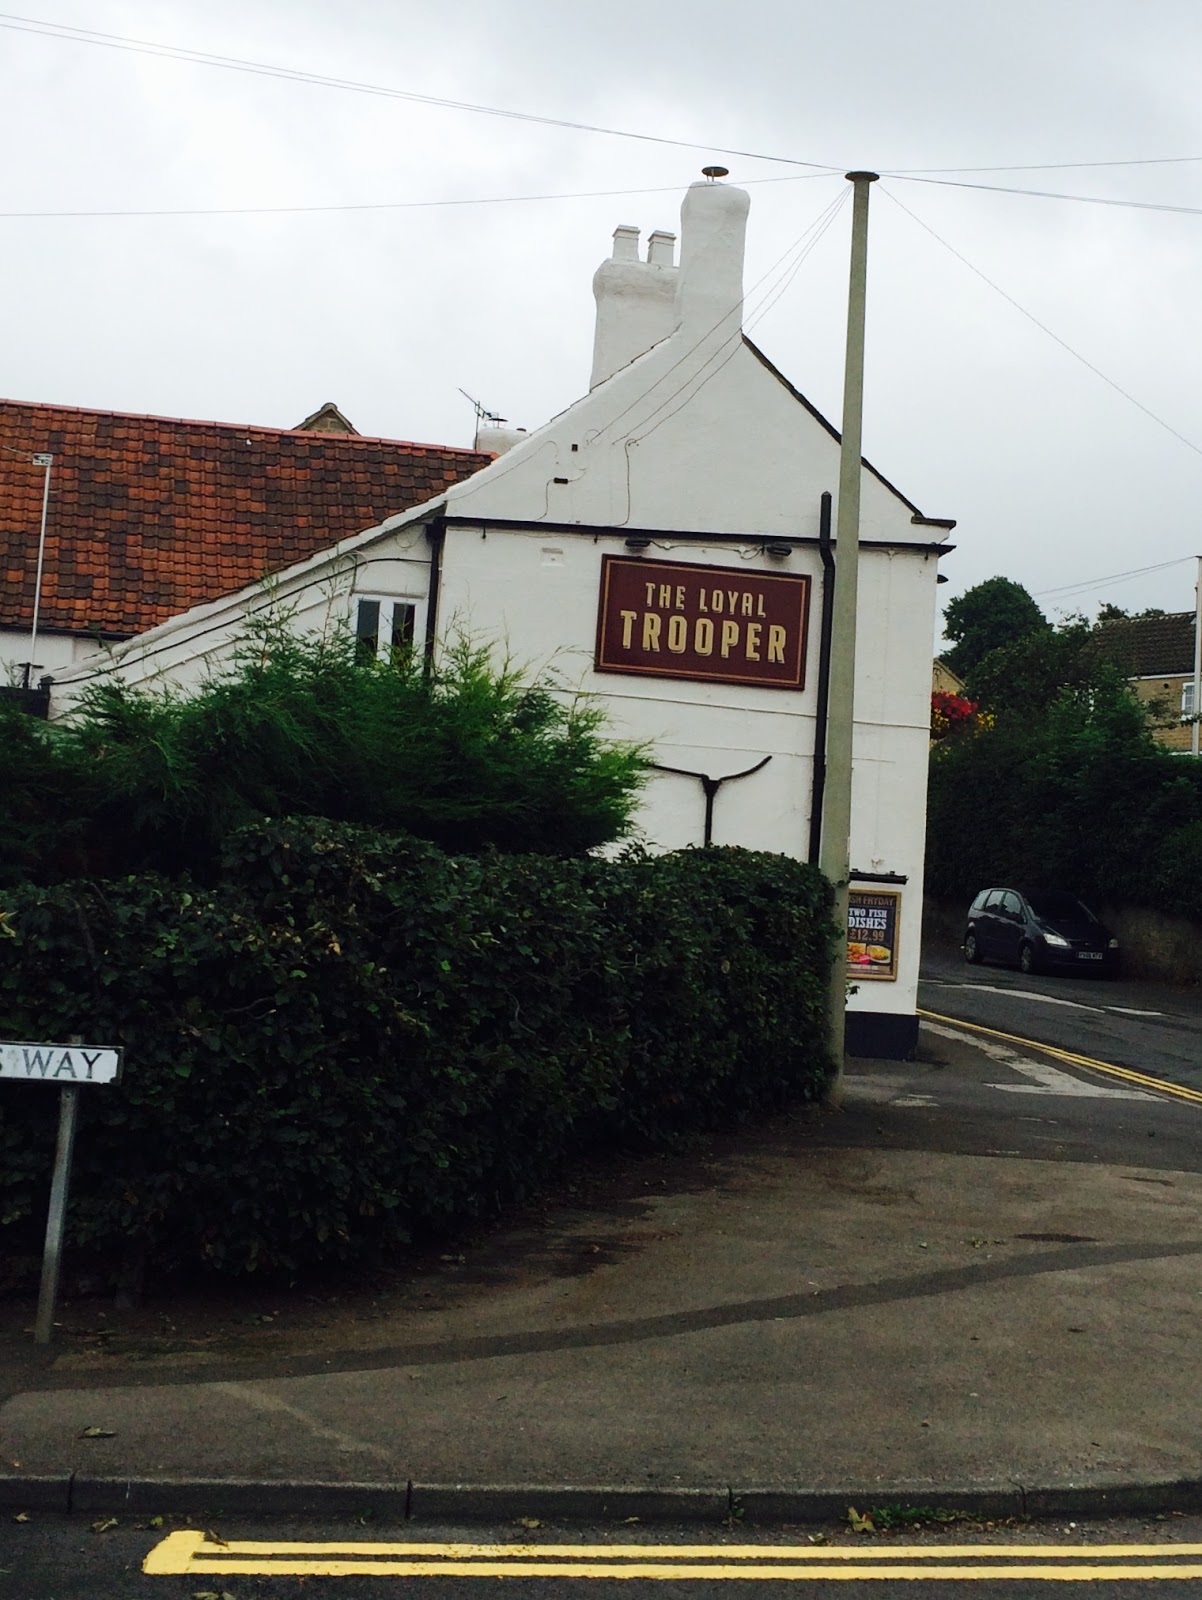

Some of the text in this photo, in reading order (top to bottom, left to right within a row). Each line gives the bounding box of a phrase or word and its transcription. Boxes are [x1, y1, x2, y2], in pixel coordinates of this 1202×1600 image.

[645, 582, 766, 618] THE LOYAL
[620, 610, 787, 664] TROOPER
[863, 897, 894, 906] FRYDAY
[848, 908, 887, 918] TWO FISH
[848, 917, 887, 930] DISHES
[850, 929, 885, 942] £12.99
[22, 1048, 102, 1079] WAY
